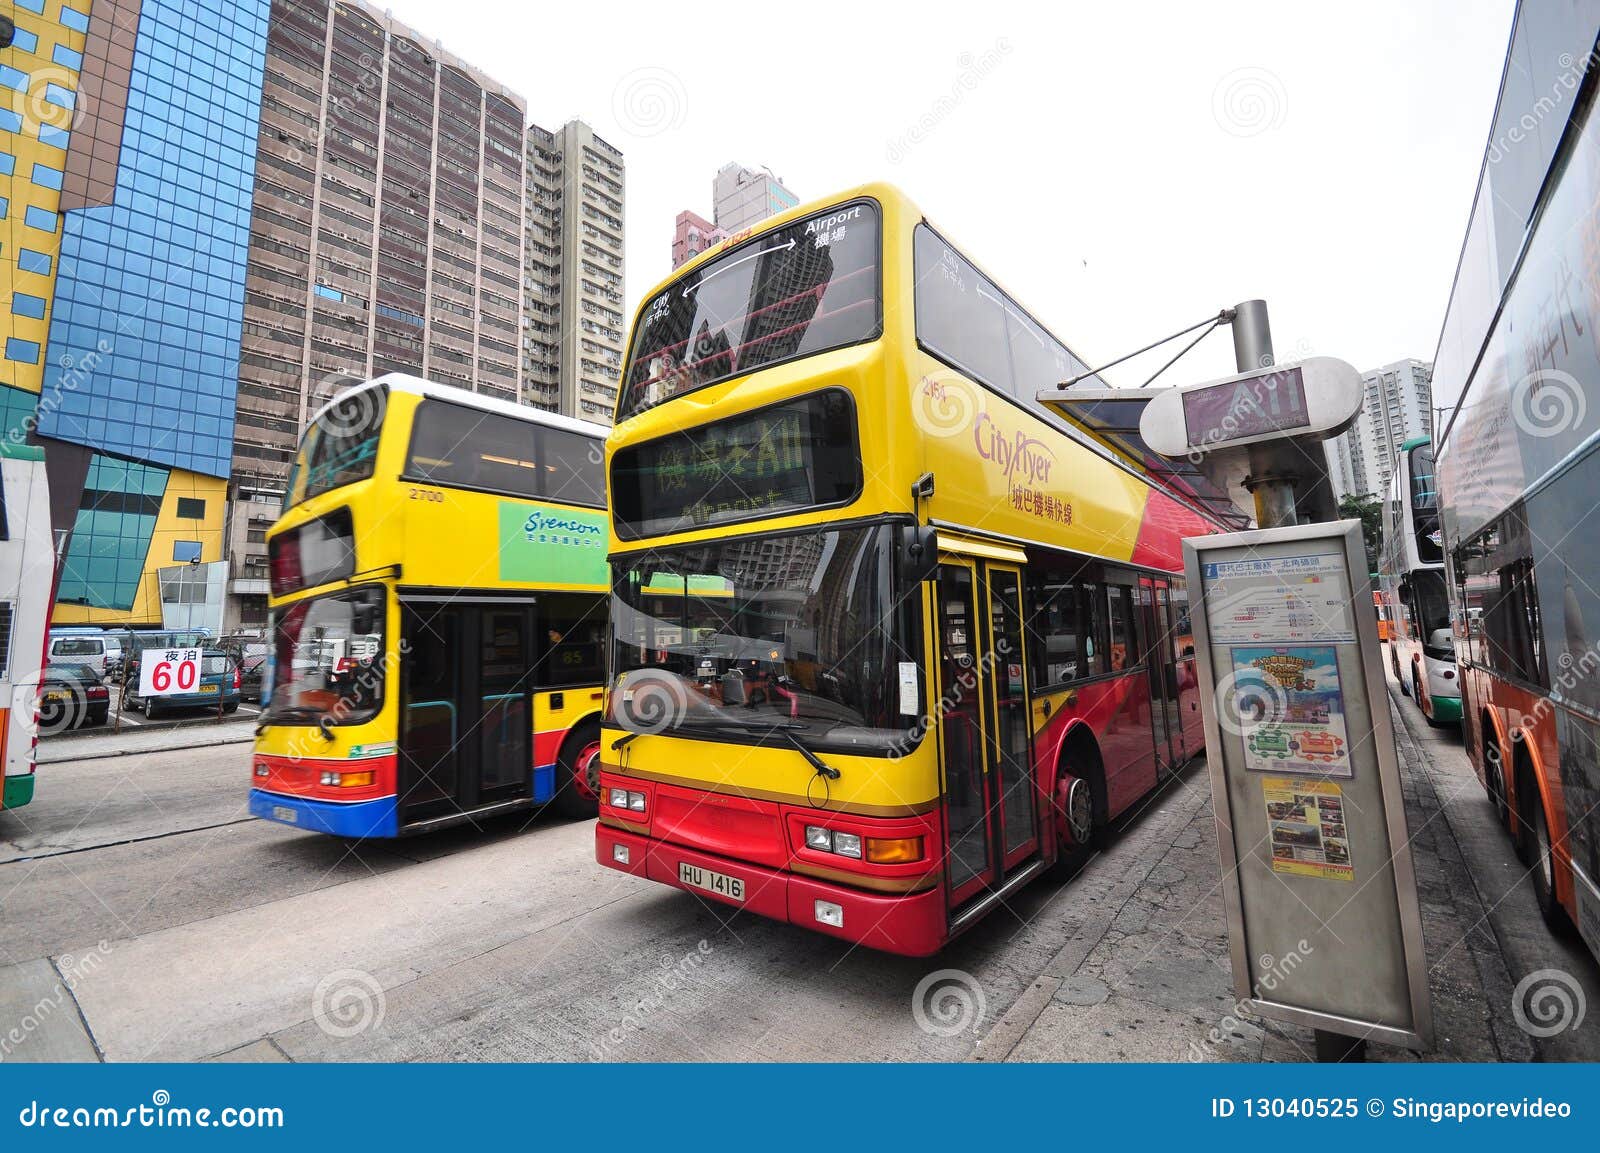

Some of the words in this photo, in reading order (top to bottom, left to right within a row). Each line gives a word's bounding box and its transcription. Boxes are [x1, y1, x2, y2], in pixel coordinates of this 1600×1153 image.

[805, 206, 861, 235] Airport
[814, 226, 847, 250] 機場
[653, 292, 670, 309] City
[409, 488, 445, 503] 2700
[1012, 484, 1073, 526] 城巴機場快線
[524, 511, 601, 534] Svenson
[165, 650, 197, 662] 夜泊
[152, 660, 196, 691] 60
[683, 865, 702, 885] HU
[711, 873, 741, 897] 1416
